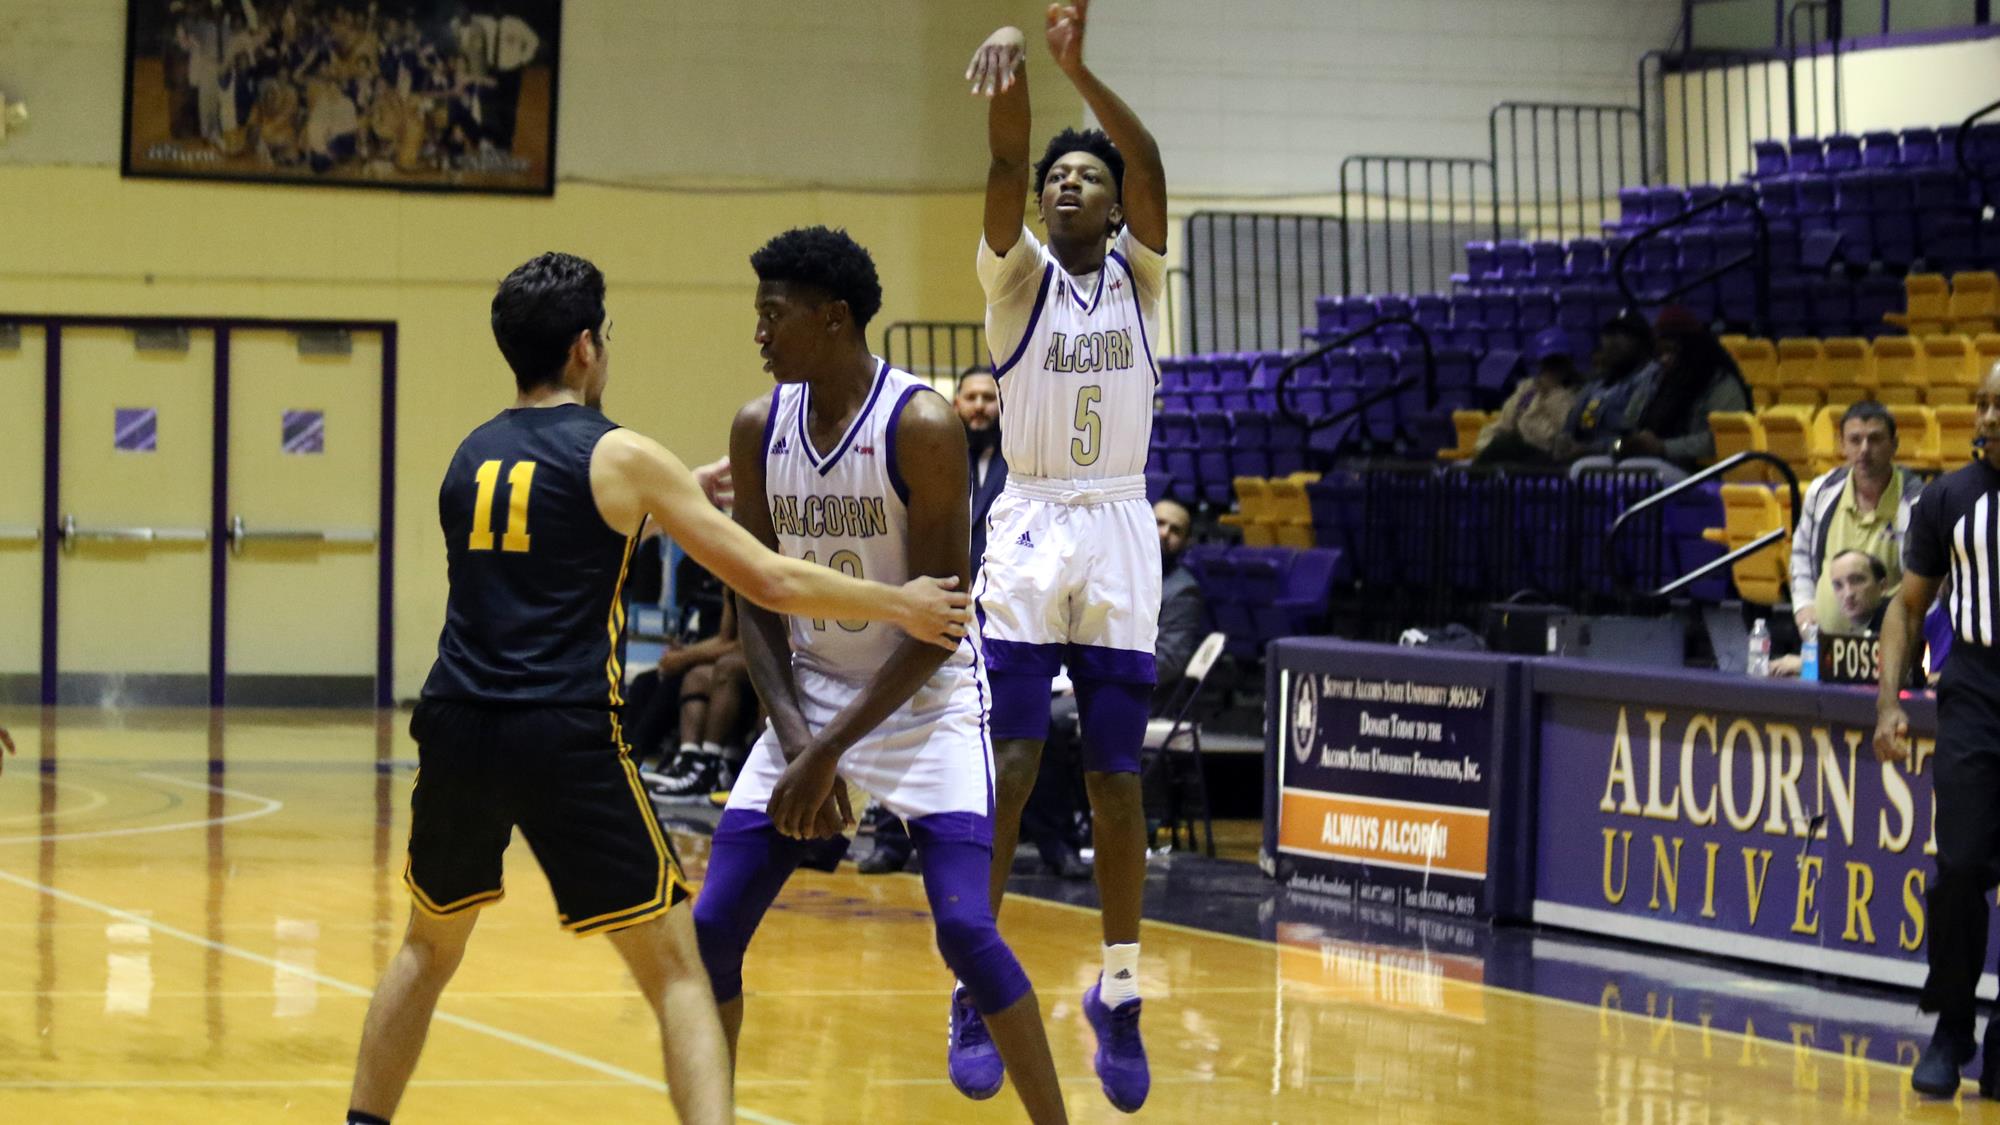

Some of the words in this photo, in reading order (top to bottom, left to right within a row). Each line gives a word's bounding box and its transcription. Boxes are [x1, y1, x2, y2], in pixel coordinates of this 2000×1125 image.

[1043, 326, 1134, 373] ALCORN
[1071, 385, 1101, 466] 5
[468, 460, 536, 552] 11
[773, 495, 887, 537] ALCORN
[1833, 638, 1880, 679] POSS
[1321, 744, 1350, 768] ALCORN
[1350, 745, 1371, 772] STATE
[1371, 747, 1413, 776] UNIVERSITY
[1600, 706, 1863, 847] ALCORN
[1322, 811, 1380, 851] ALWAYS
[1381, 819, 1449, 860] ALCORN!
